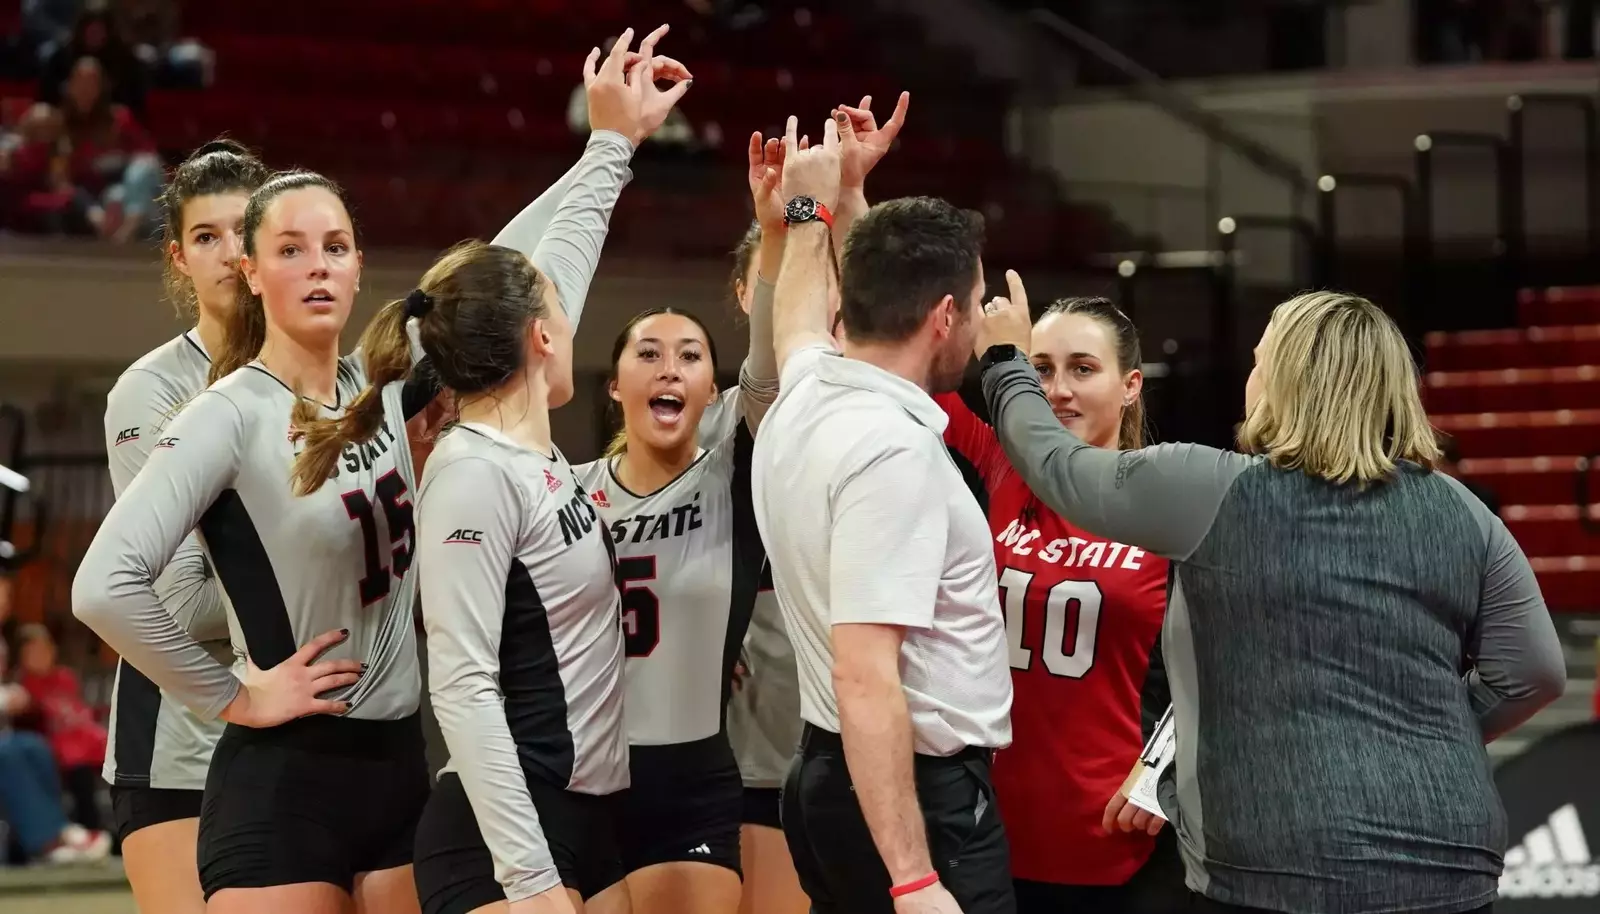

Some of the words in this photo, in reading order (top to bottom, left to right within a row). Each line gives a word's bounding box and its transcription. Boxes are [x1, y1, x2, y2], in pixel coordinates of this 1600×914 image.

[115, 427, 140, 443] ACC
[155, 437, 180, 447] CC
[340, 467, 416, 608] 15
[446, 529, 484, 541] ACC
[611, 491, 702, 544] STATE
[996, 518, 1041, 555] NC
[1038, 537, 1145, 570] STATE
[614, 555, 660, 657] 5
[998, 567, 1103, 680] 10
